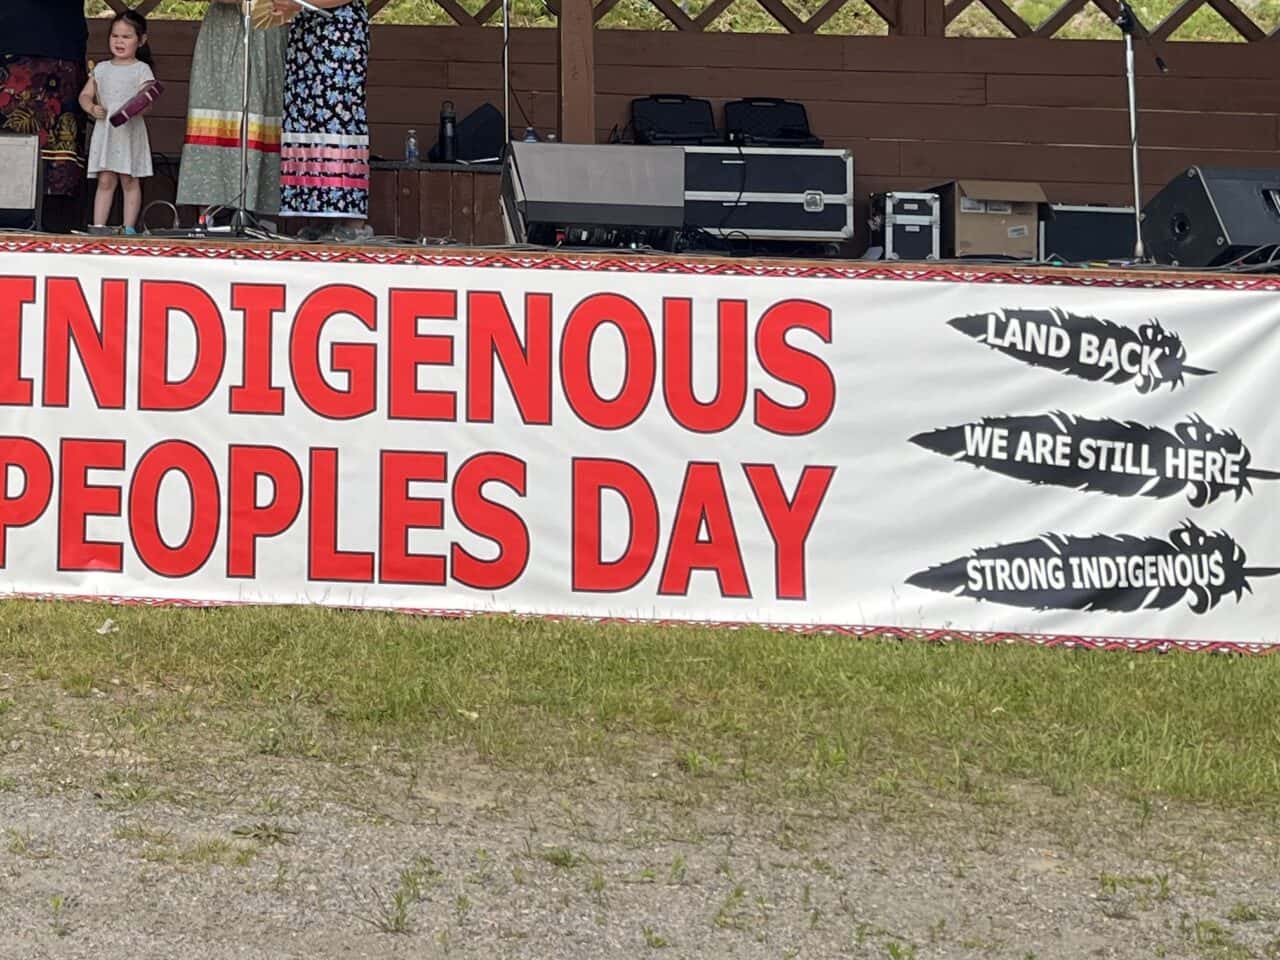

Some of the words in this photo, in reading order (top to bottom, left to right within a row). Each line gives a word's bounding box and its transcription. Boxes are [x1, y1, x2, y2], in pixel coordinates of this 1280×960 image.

[986, 314, 1070, 359] LAND
[1078, 332, 1162, 378] BACK
[964, 425, 1009, 460] WE
[1014, 430, 1071, 466] ARE
[1078, 438, 1157, 476] STILL
[1165, 446, 1242, 485] HERE
[571, 456, 836, 602] DAY
[967, 557, 1064, 590] STRONG
[1069, 554, 1225, 590] INDIGENOUS
